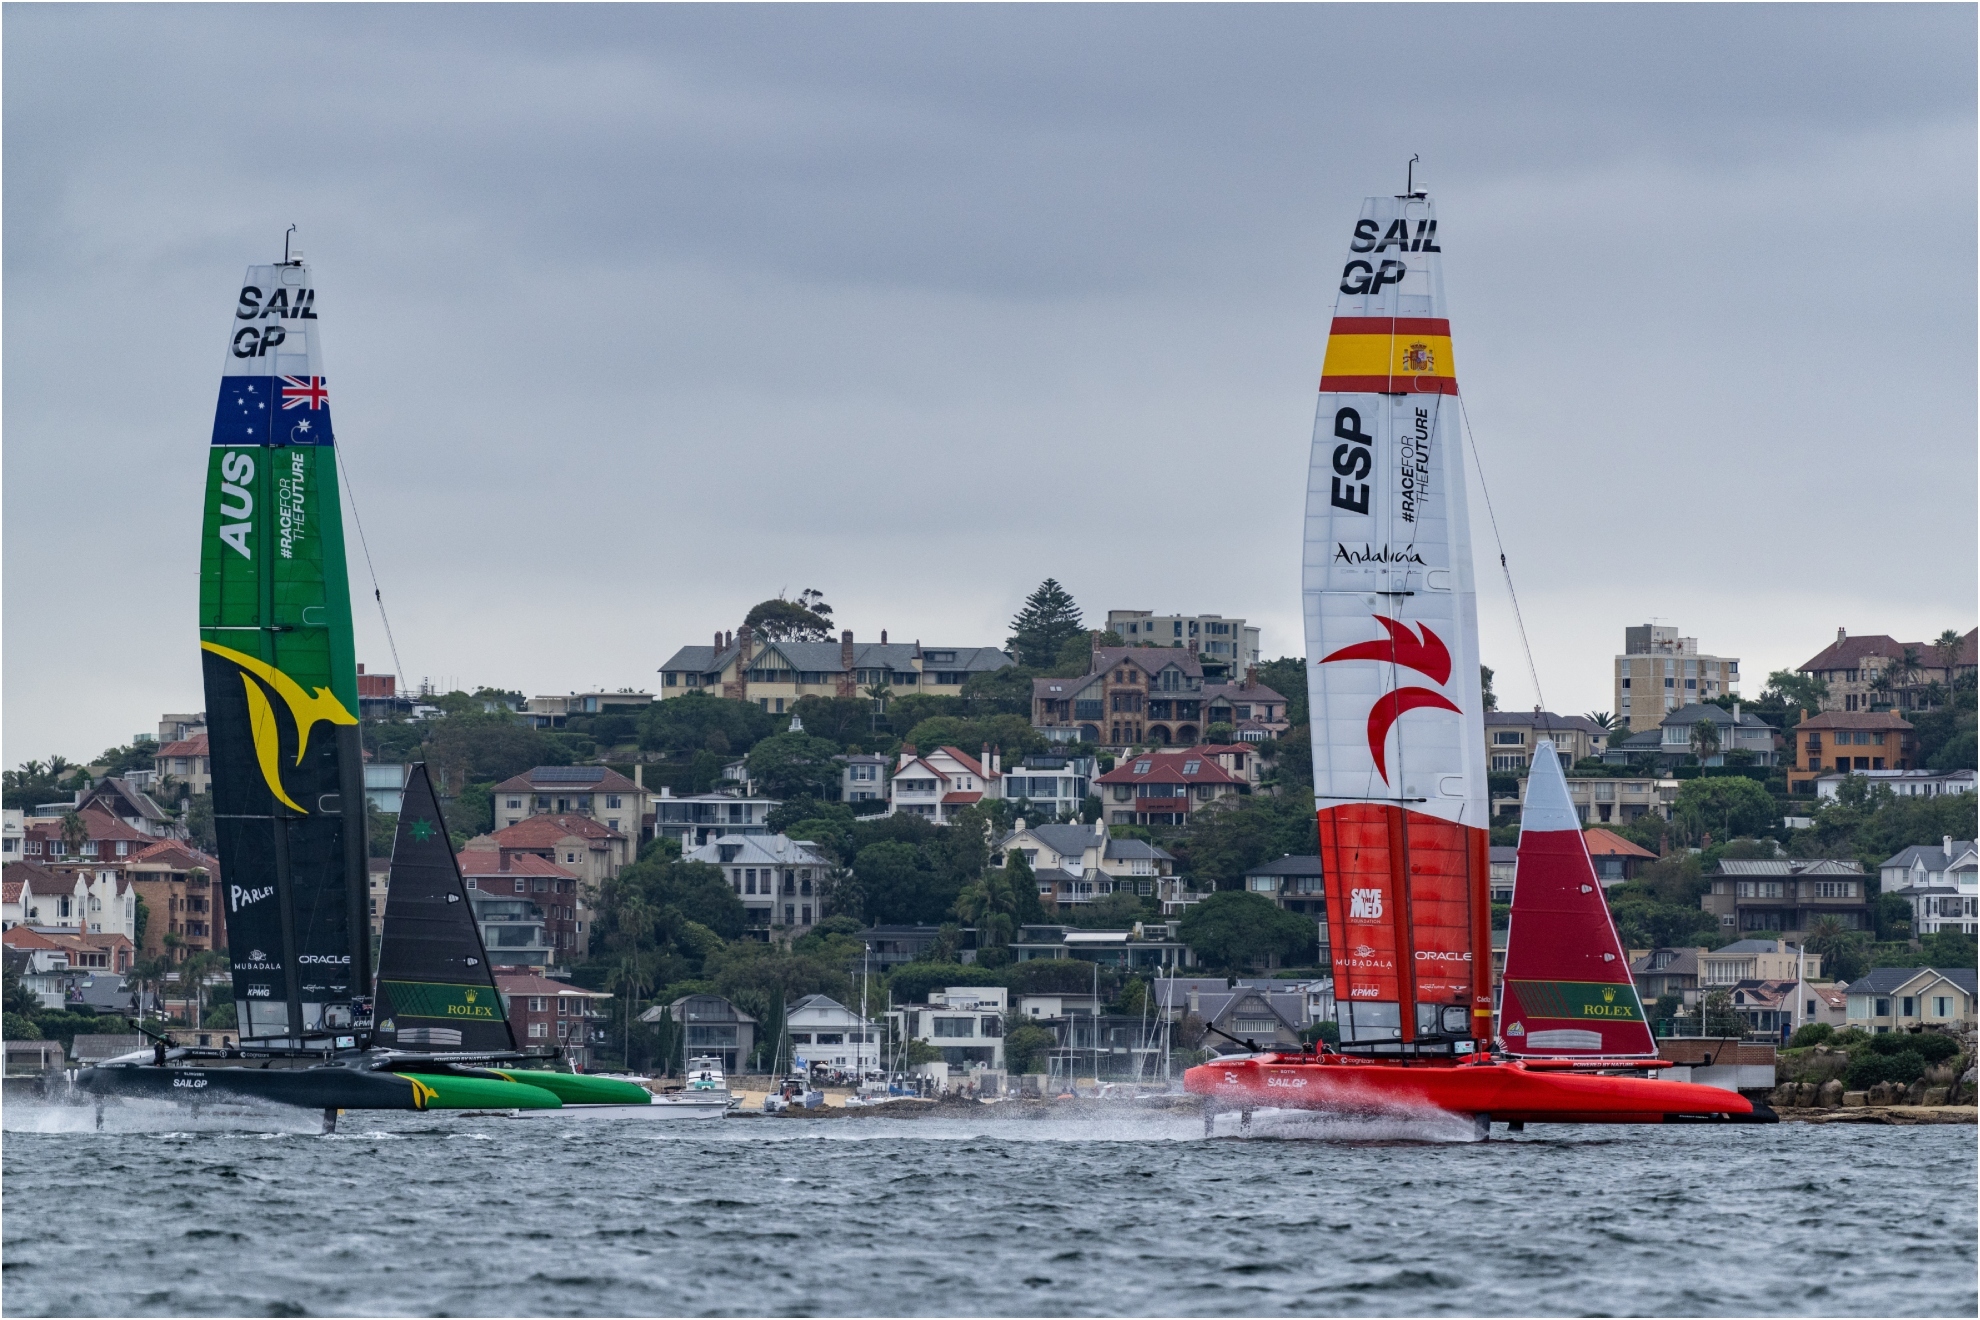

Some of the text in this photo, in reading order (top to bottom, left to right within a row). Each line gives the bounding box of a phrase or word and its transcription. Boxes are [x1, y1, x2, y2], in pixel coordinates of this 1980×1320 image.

[1350, 218, 1441, 254] SAIL
[1339, 259, 1406, 295] GP
[235, 285, 318, 320] SAIL
[231, 325, 286, 359] GP
[1331, 406, 1373, 516] ESP
[219, 451, 255, 560] AUS
[1351, 888, 1382, 903] SAVE
[1350, 903, 1383, 918] MED
[298, 955, 351, 964] ORACLE
[1335, 959, 1393, 968] MUBADALA
[1414, 951, 1472, 961] ORACLE
[247, 988, 270, 997] KPMG
[1351, 988, 1379, 997] KPMG
[447, 1004, 493, 1017] ROLEX
[1583, 1004, 1633, 1017] ROLEX
